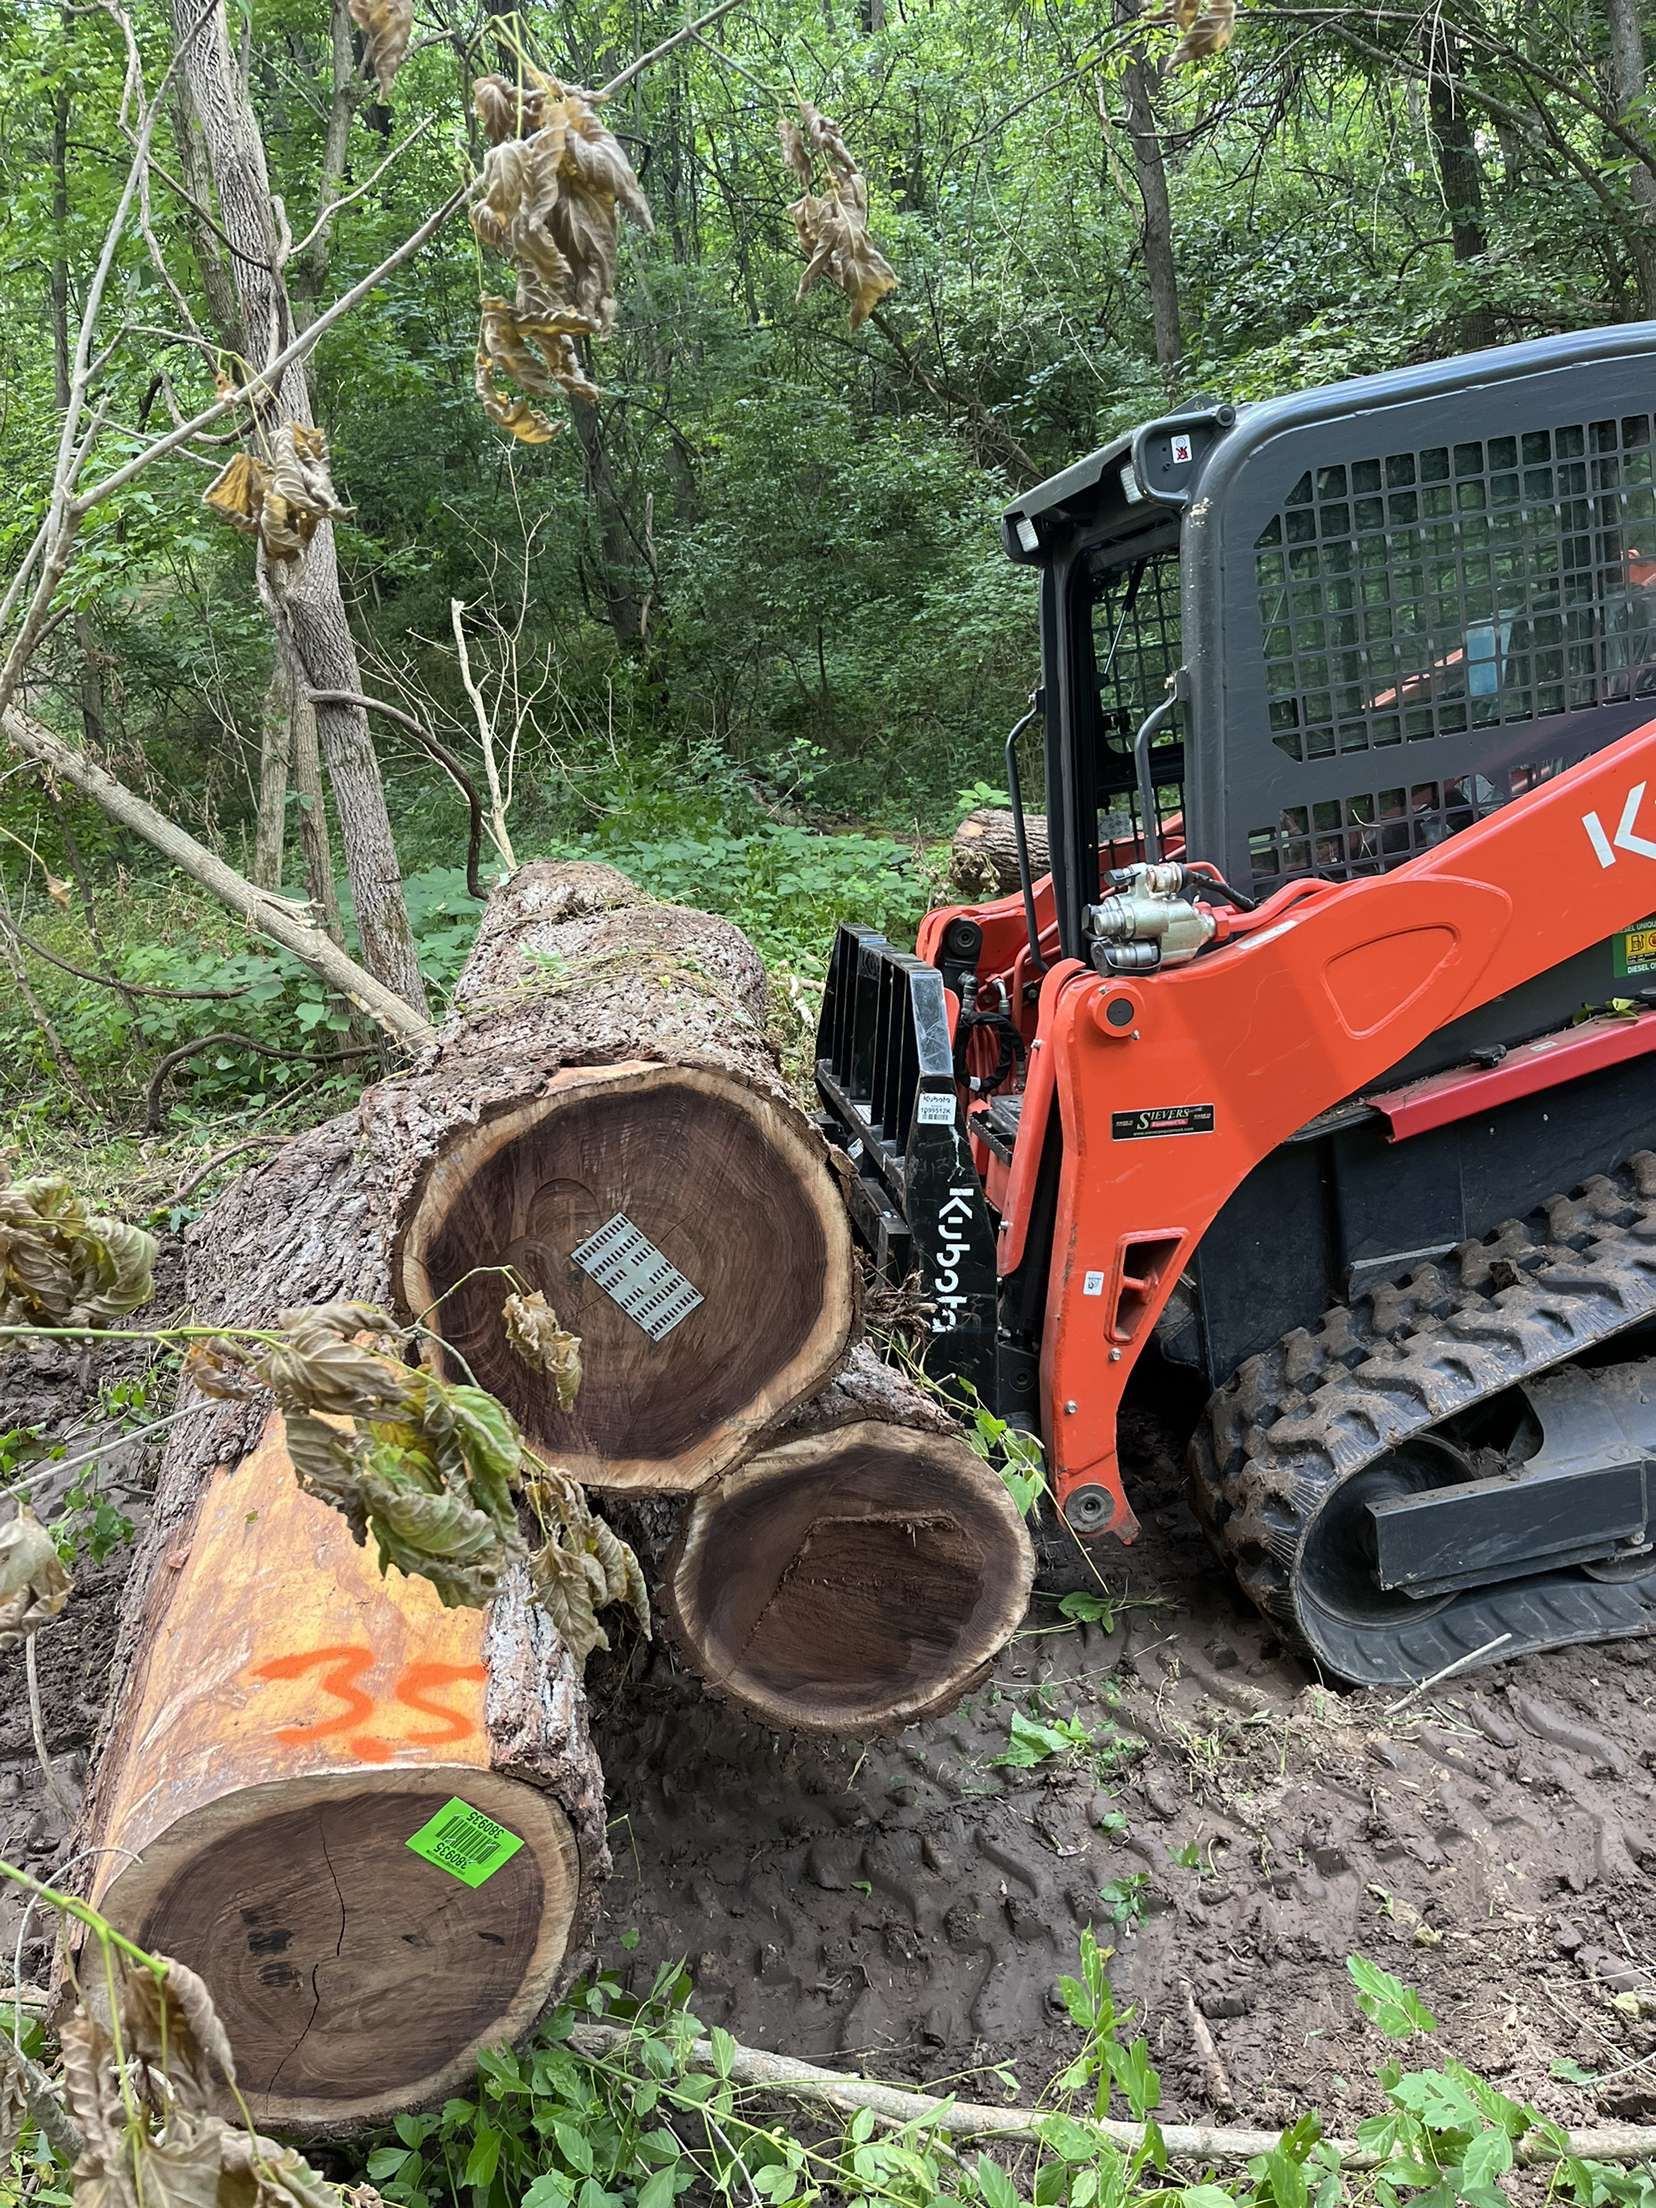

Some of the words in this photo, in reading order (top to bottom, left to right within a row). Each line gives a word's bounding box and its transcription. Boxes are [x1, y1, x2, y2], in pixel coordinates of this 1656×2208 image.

[1581, 781, 1656, 869] K
[1627, 963, 1650, 974] DIESEL
[1136, 1108, 1190, 1130] SIEVERS
[931, 1188, 974, 1333] Kubota
[466, 1811, 505, 1839] 380935
[433, 1842, 474, 1870] 380935
